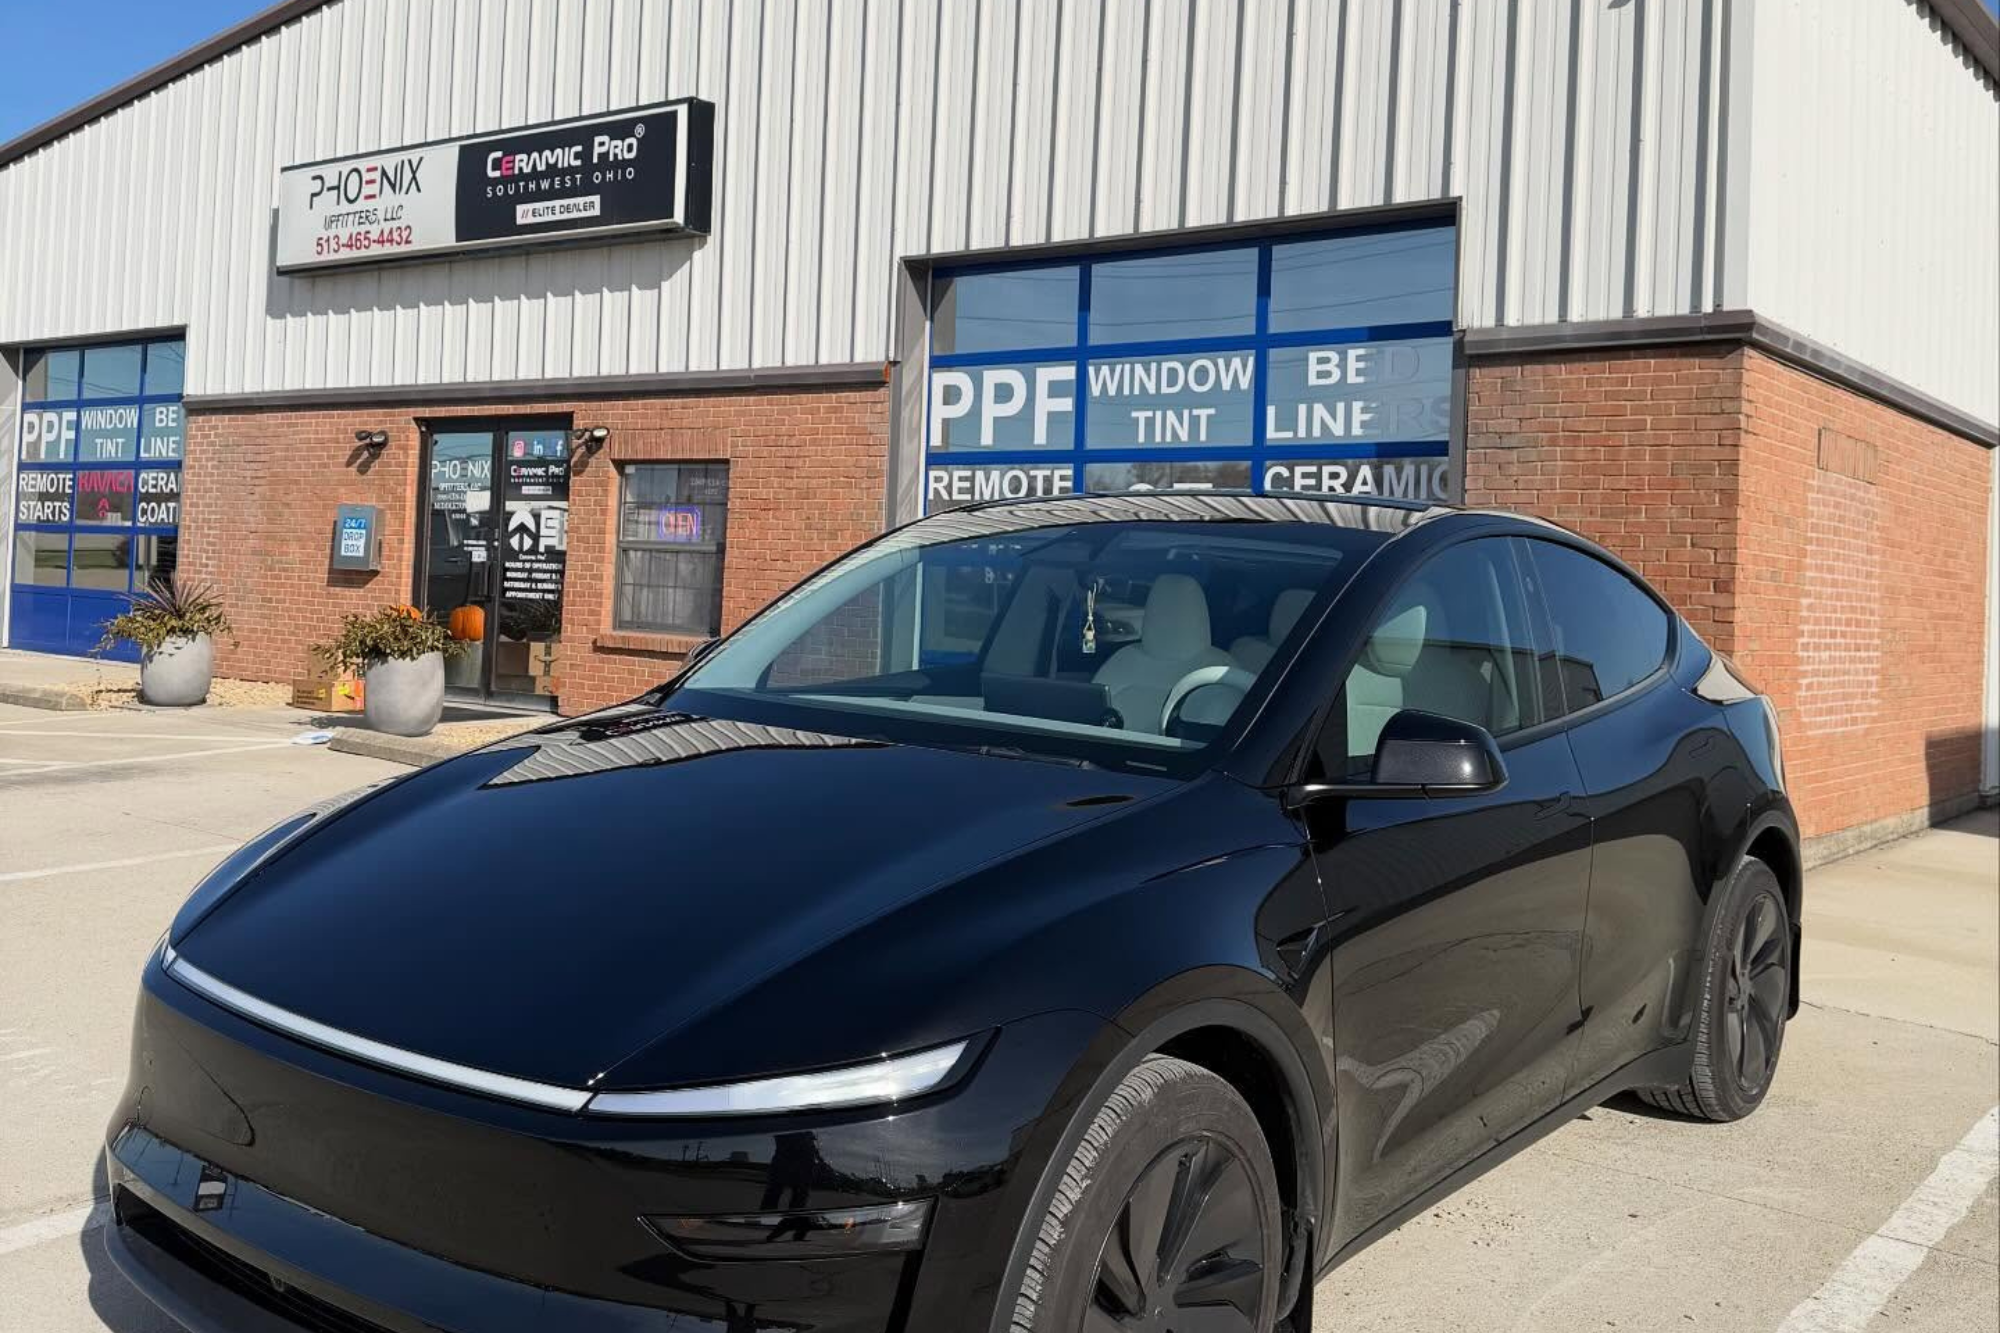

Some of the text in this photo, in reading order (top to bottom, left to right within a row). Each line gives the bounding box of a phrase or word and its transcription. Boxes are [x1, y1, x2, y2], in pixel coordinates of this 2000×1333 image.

[486, 145, 583, 178] CERAMIC
[309, 156, 424, 210] PHOENIX
[486, 167, 635, 198] SOUTHWEST OHIO
[383, 204, 404, 222] LLC
[531, 200, 596, 218] ELITE DEALER
[315, 225, 413, 256] 513-465-4432
[1088, 356, 1254, 397] WINDOW
[81, 407, 140, 430] WINDOW
[929, 366, 1077, 447] PPF
[20, 411, 77, 460] PPF
[1131, 408, 1216, 443] TINT
[95, 438, 126, 459] TINT
[18, 473, 74, 494] REMOTE
[927, 468, 1073, 500] REMOTE
[18, 501, 71, 522] STARTS
[345, 518, 366, 528] 24/7
[344, 531, 365, 541] DROP
